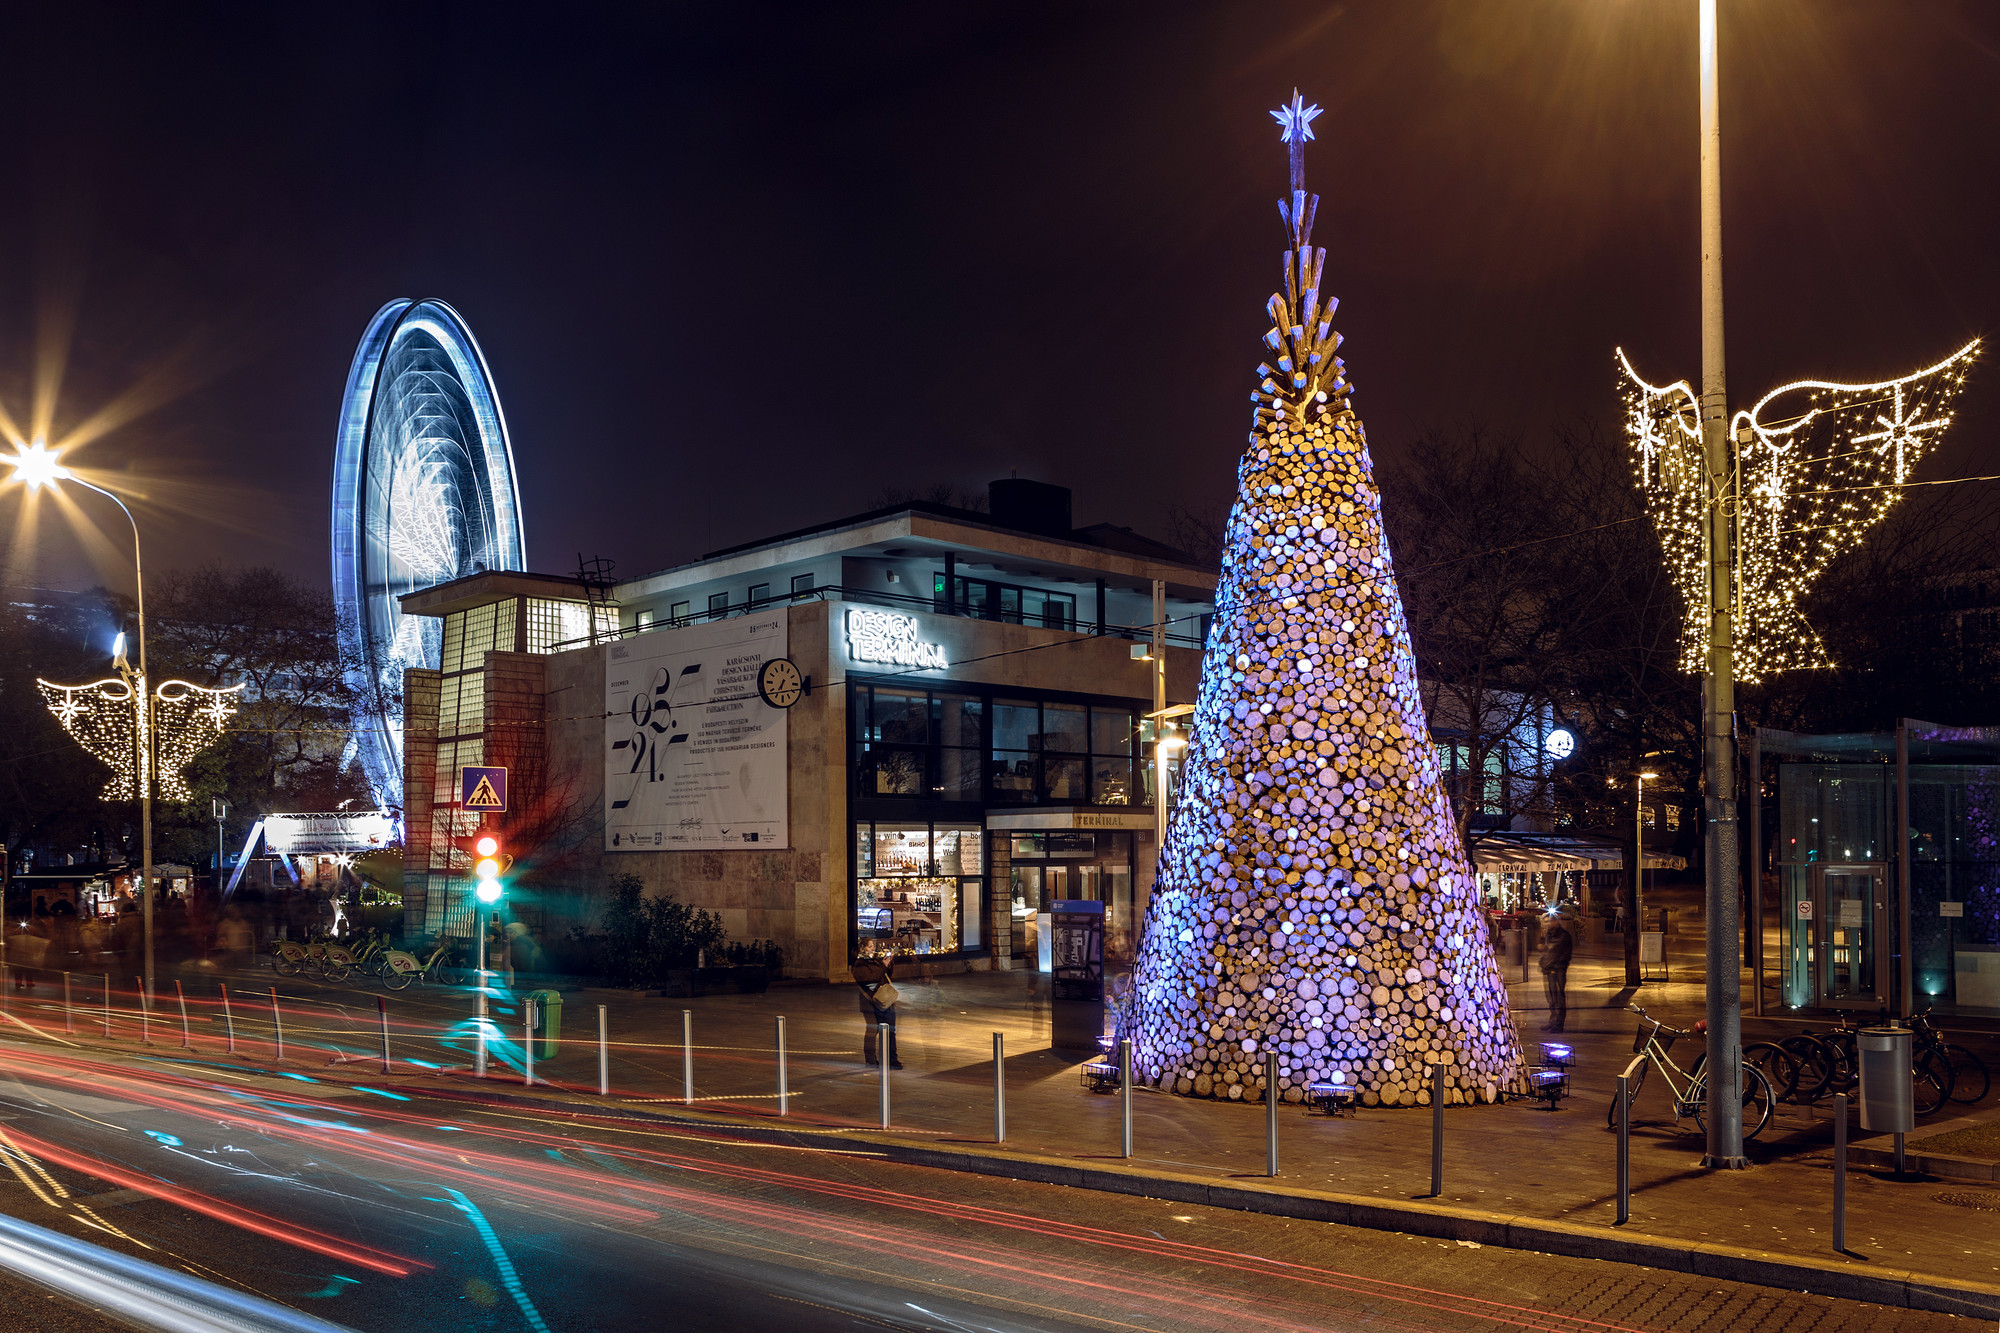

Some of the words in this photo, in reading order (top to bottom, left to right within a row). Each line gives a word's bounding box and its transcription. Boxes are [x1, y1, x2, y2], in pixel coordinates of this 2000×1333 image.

[846, 609, 919, 641] DESIGN
[848, 634, 949, 669] TERMINAL
[726, 654, 761, 666] KARÁCSONYI
[722, 667, 742, 676] DESIGN
[714, 685, 745, 695] CHRISTMAS
[750, 742, 775, 750] DESIGNERS
[1077, 816, 1124, 826] TERMINAL
